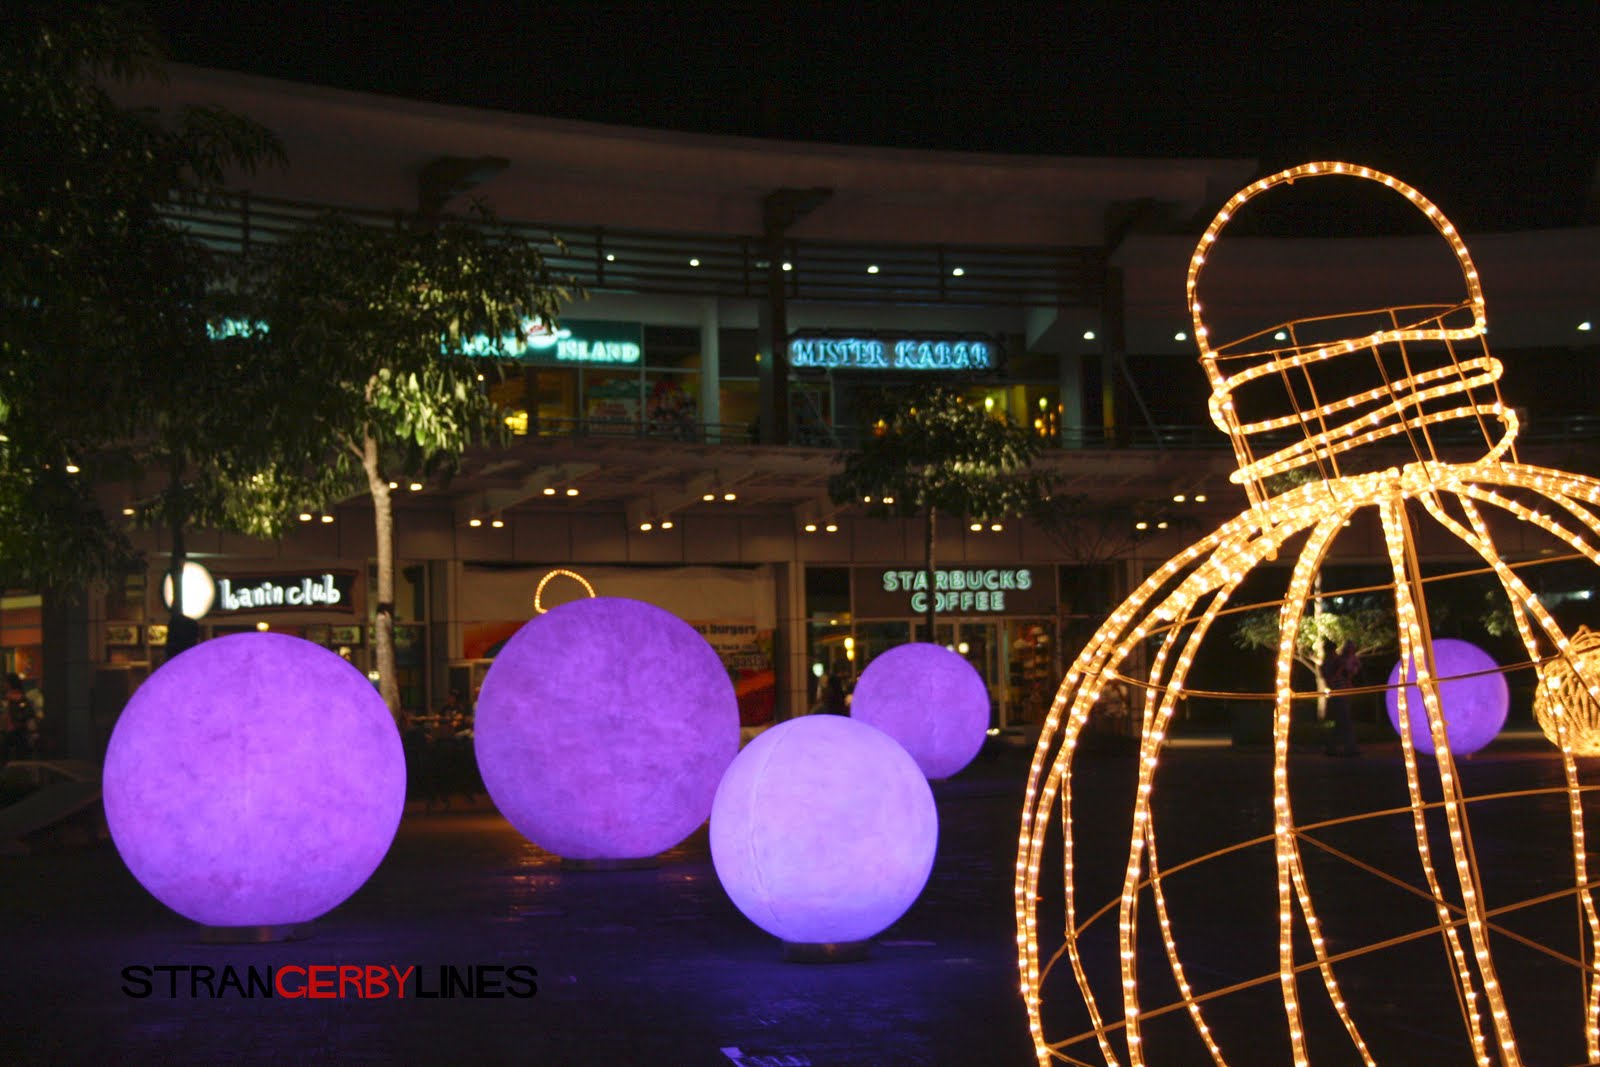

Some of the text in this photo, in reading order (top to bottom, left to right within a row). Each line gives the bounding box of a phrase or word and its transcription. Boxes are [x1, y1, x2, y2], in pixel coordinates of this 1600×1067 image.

[556, 339, 641, 364] ISLAND
[792, 338, 889, 368] MISTER
[219, 573, 341, 611] kanin club
[882, 569, 1032, 592] STARBUCKS
